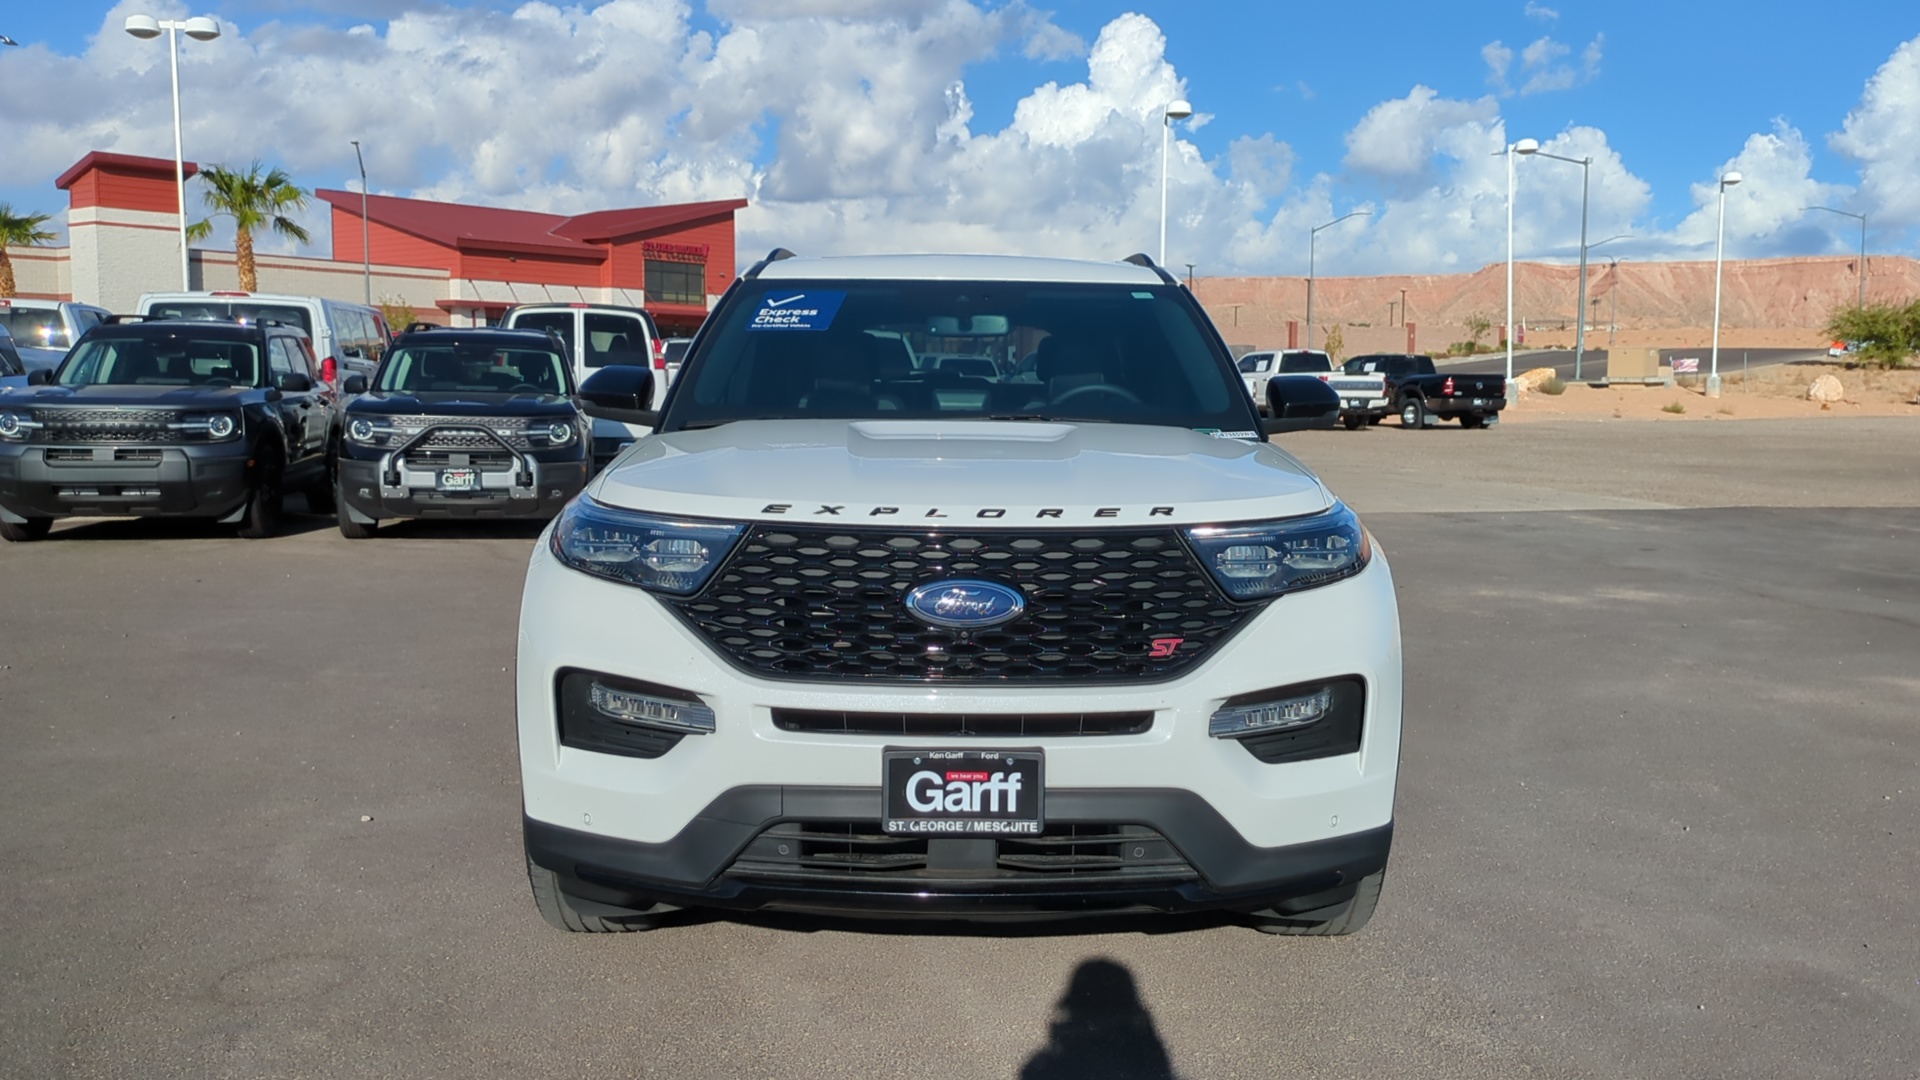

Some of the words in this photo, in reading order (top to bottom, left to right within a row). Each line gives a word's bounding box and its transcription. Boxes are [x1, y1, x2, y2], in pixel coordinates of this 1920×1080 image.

[759, 308, 818, 316] Express
[755, 316, 800, 324] Check
[442, 473, 475, 486] Garff
[760, 503, 1176, 518] EXPLORER
[934, 588, 996, 615] Ford
[1148, 638, 1184, 656] ST
[981, 752, 999, 760] Ford
[906, 770, 1022, 813] Garff
[888, 822, 906, 832] ST.
[910, 822, 964, 832] GEORGE
